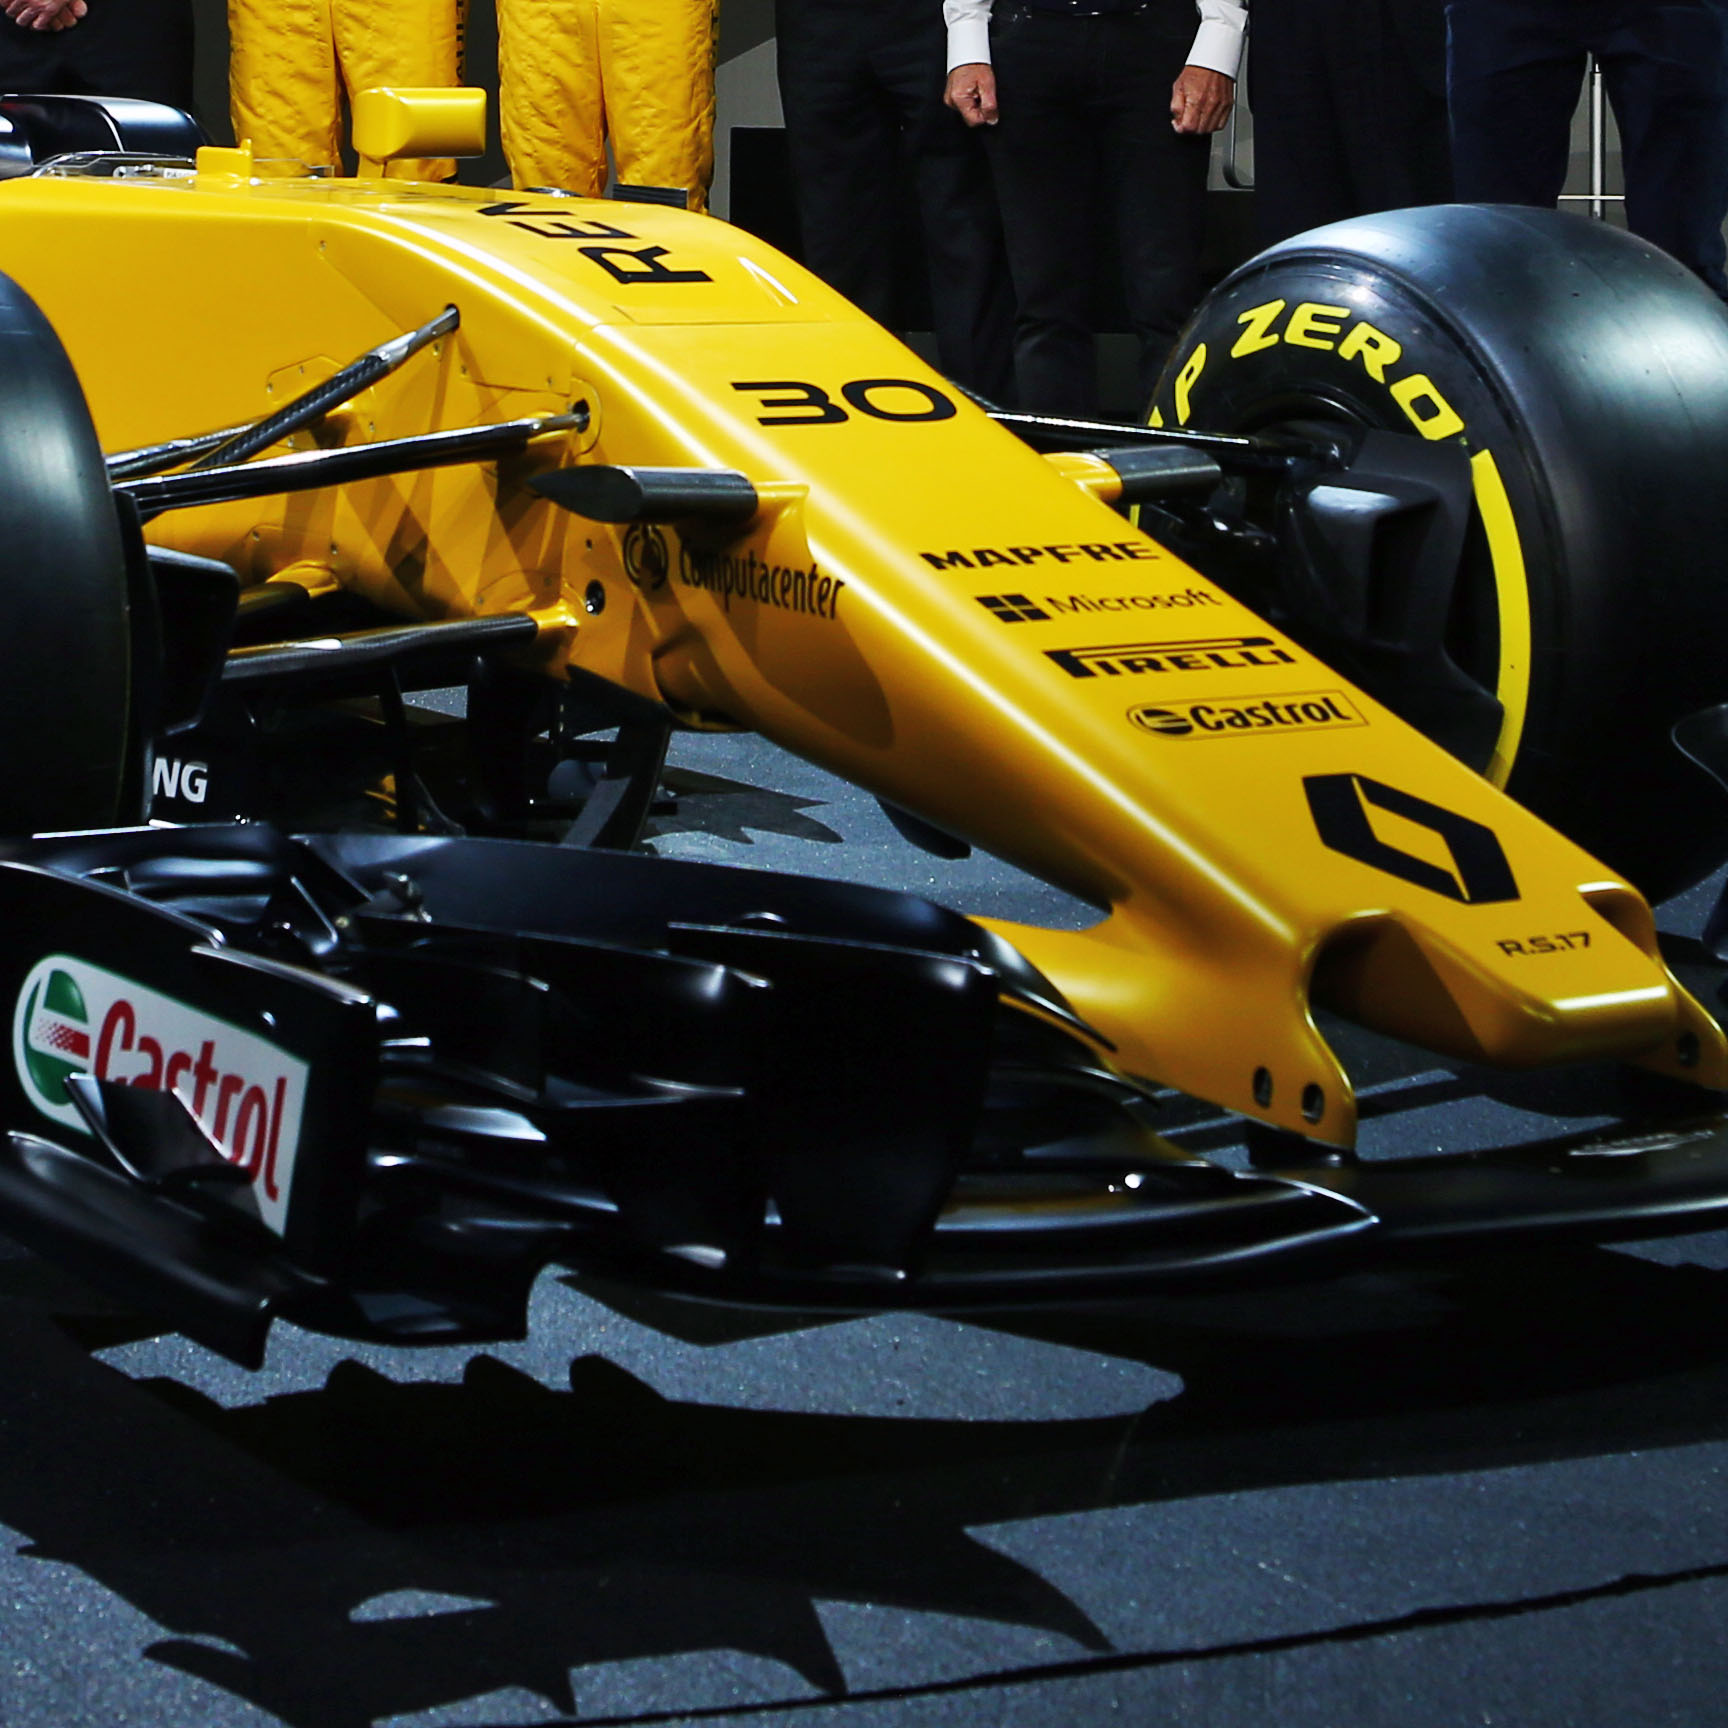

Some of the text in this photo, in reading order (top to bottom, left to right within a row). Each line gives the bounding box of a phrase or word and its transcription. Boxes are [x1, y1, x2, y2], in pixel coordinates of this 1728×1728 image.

[1174, 298, 1466, 442] P ZERO
[730, 379, 958, 427] 30
[680, 534, 846, 621] Computacenter
[919, 541, 1163, 571] MAPFRE
[1047, 587, 1223, 618] Microsoft
[1043, 635, 1298, 678] PIRELLI
[1189, 695, 1352, 733] Castrol
